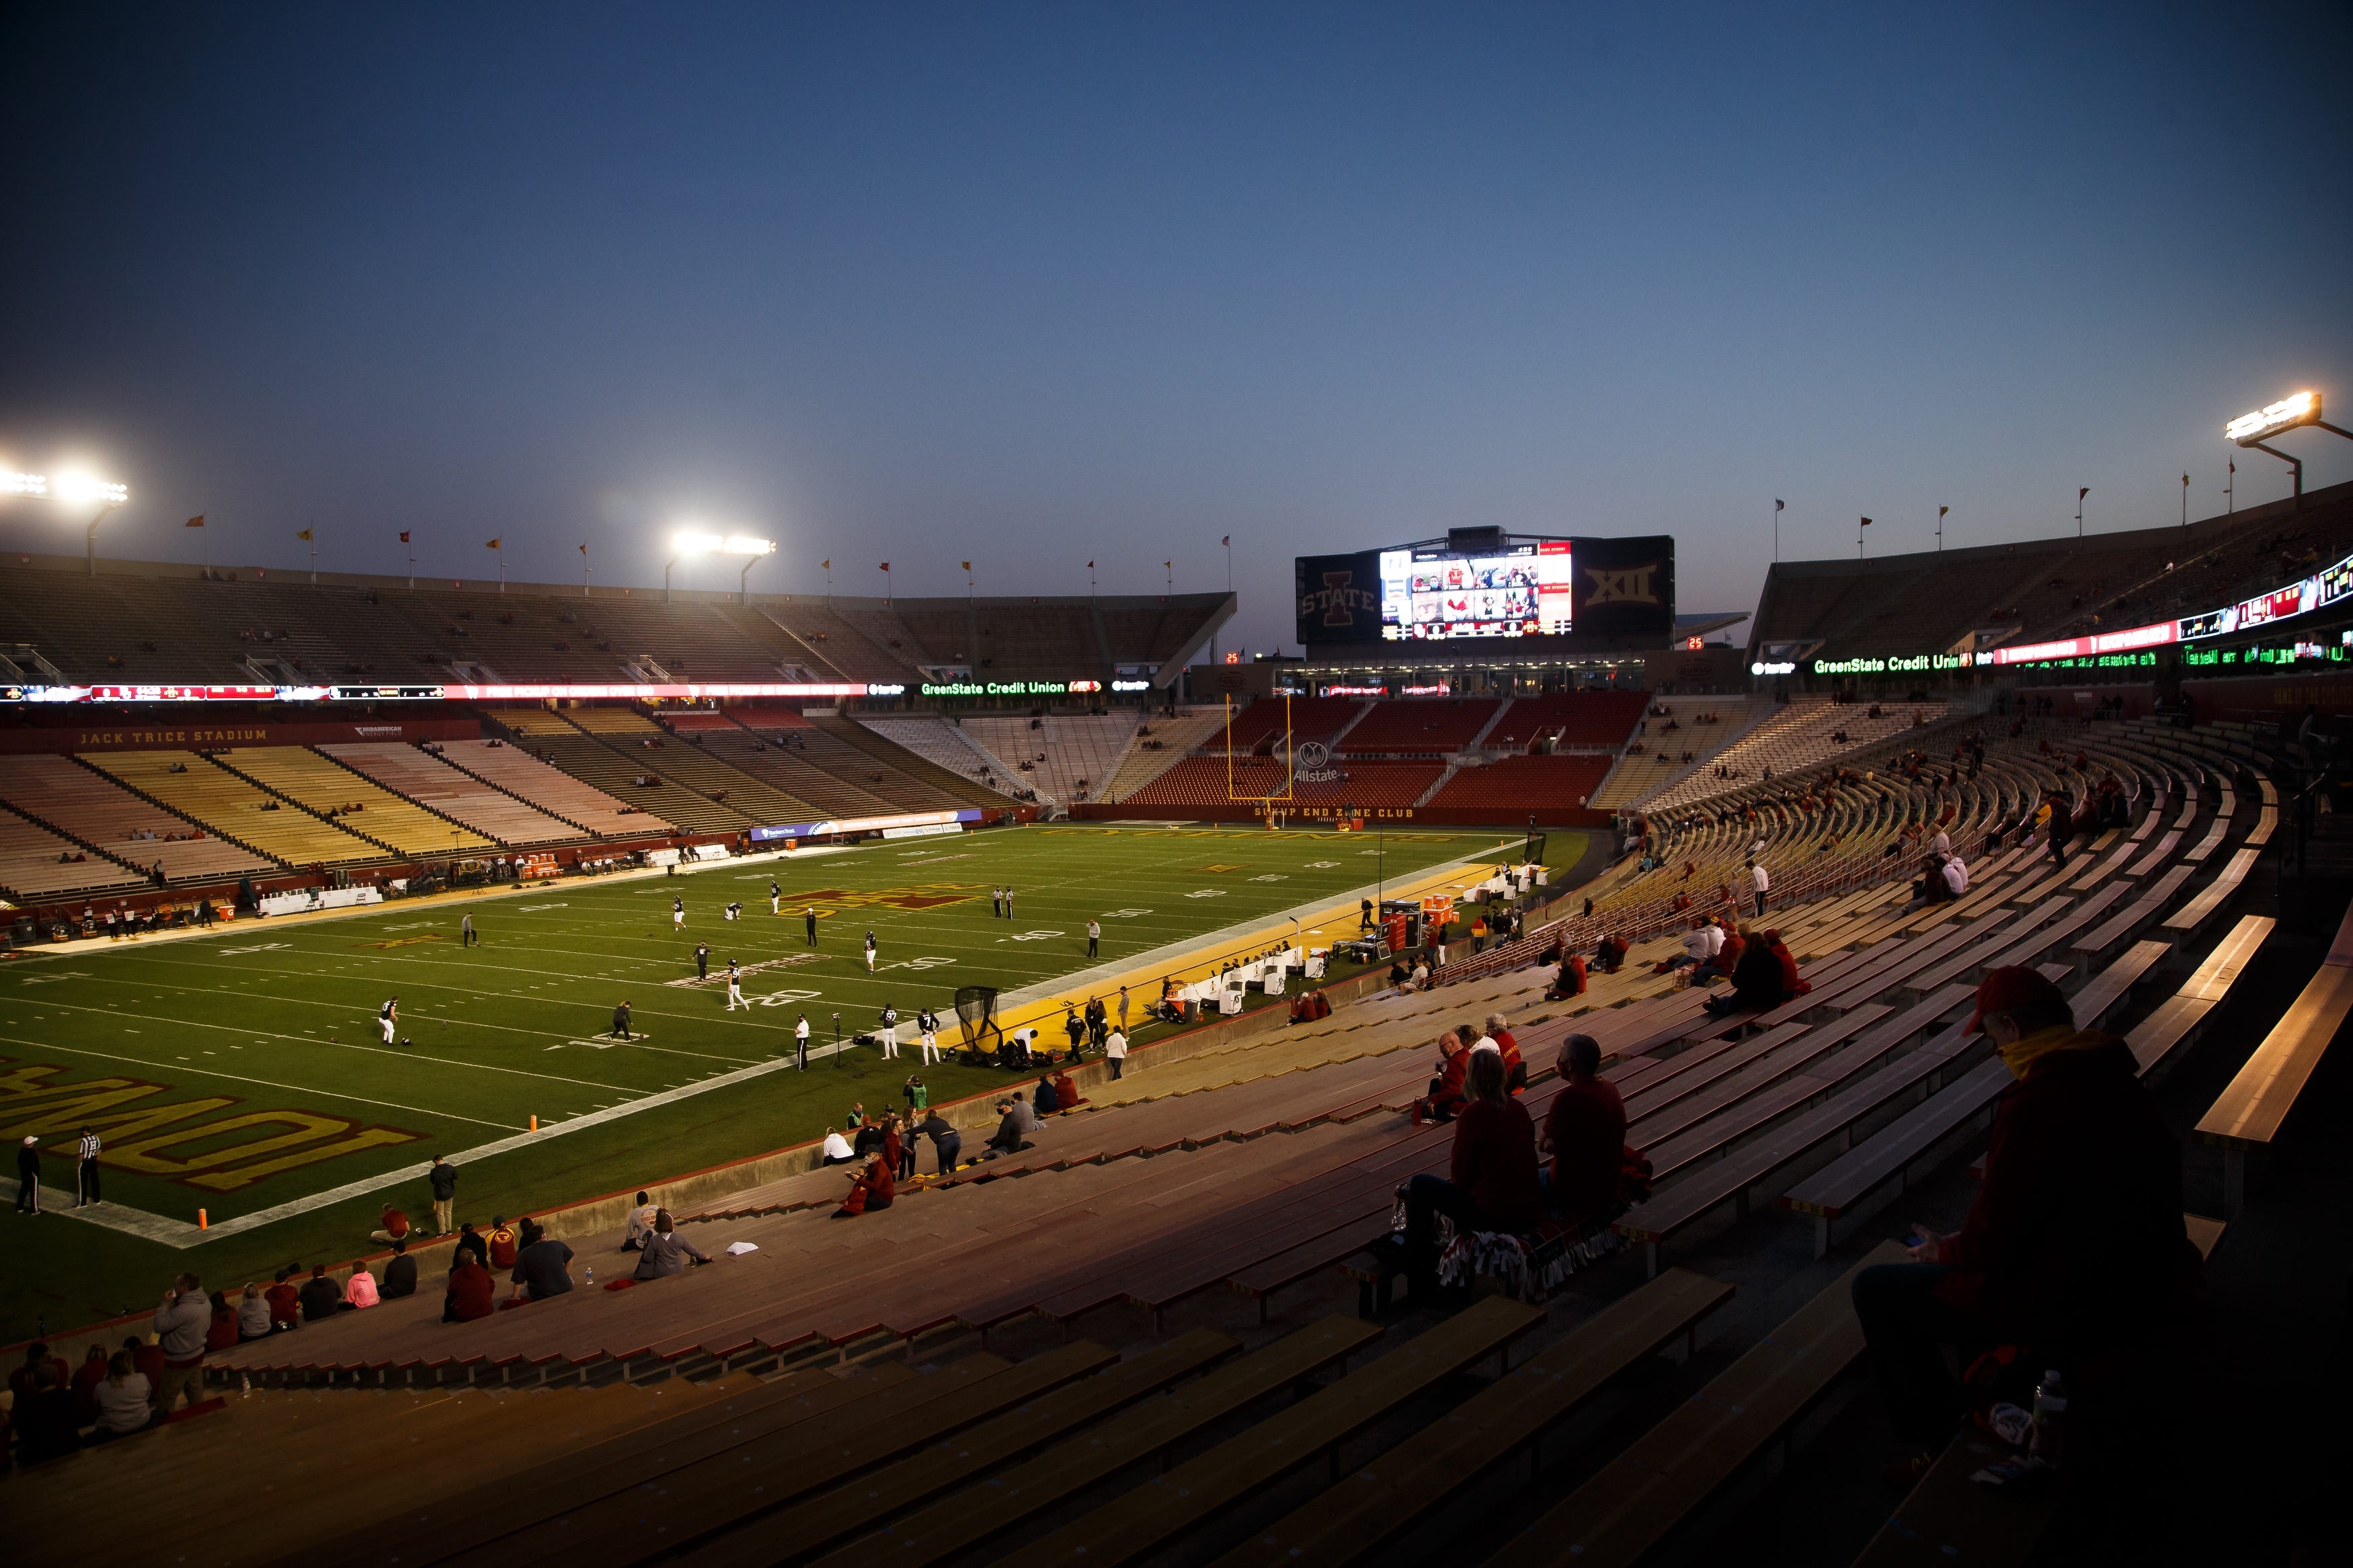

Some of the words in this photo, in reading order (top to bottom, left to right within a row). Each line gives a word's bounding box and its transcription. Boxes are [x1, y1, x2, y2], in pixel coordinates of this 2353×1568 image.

[1584, 564, 1658, 608] XII
[1302, 587, 1375, 615] STATE
[1689, 638, 1702, 648] 25
[1228, 653, 1238, 663] 25
[1815, 657, 1884, 673] GreenState
[1888, 655, 1928, 671] Credit
[1933, 653, 1958, 669] Union
[922, 683, 984, 695] GreenState
[987, 682, 1025, 694] Credit
[1029, 682, 1064, 693] Union
[81, 734, 123, 744] JACK
[132, 732, 185, 743] TRICE
[194, 730, 267, 741] STADIUM
[1293, 768, 1337, 782] Allstate
[1304, 808, 1329, 817] END
[1337, 809, 1371, 817] ZNE
[1378, 809, 1413, 817] CLUB
[1109, 908, 1154, 917] 50
[1011, 930, 1066, 941] 40
[889, 956, 957, 971] 30
[745, 989, 823, 1007] 20
[885, 1012, 898, 1022] 97
[924, 1016, 931, 1027] 7
[567, 1030, 650, 1049] 10
